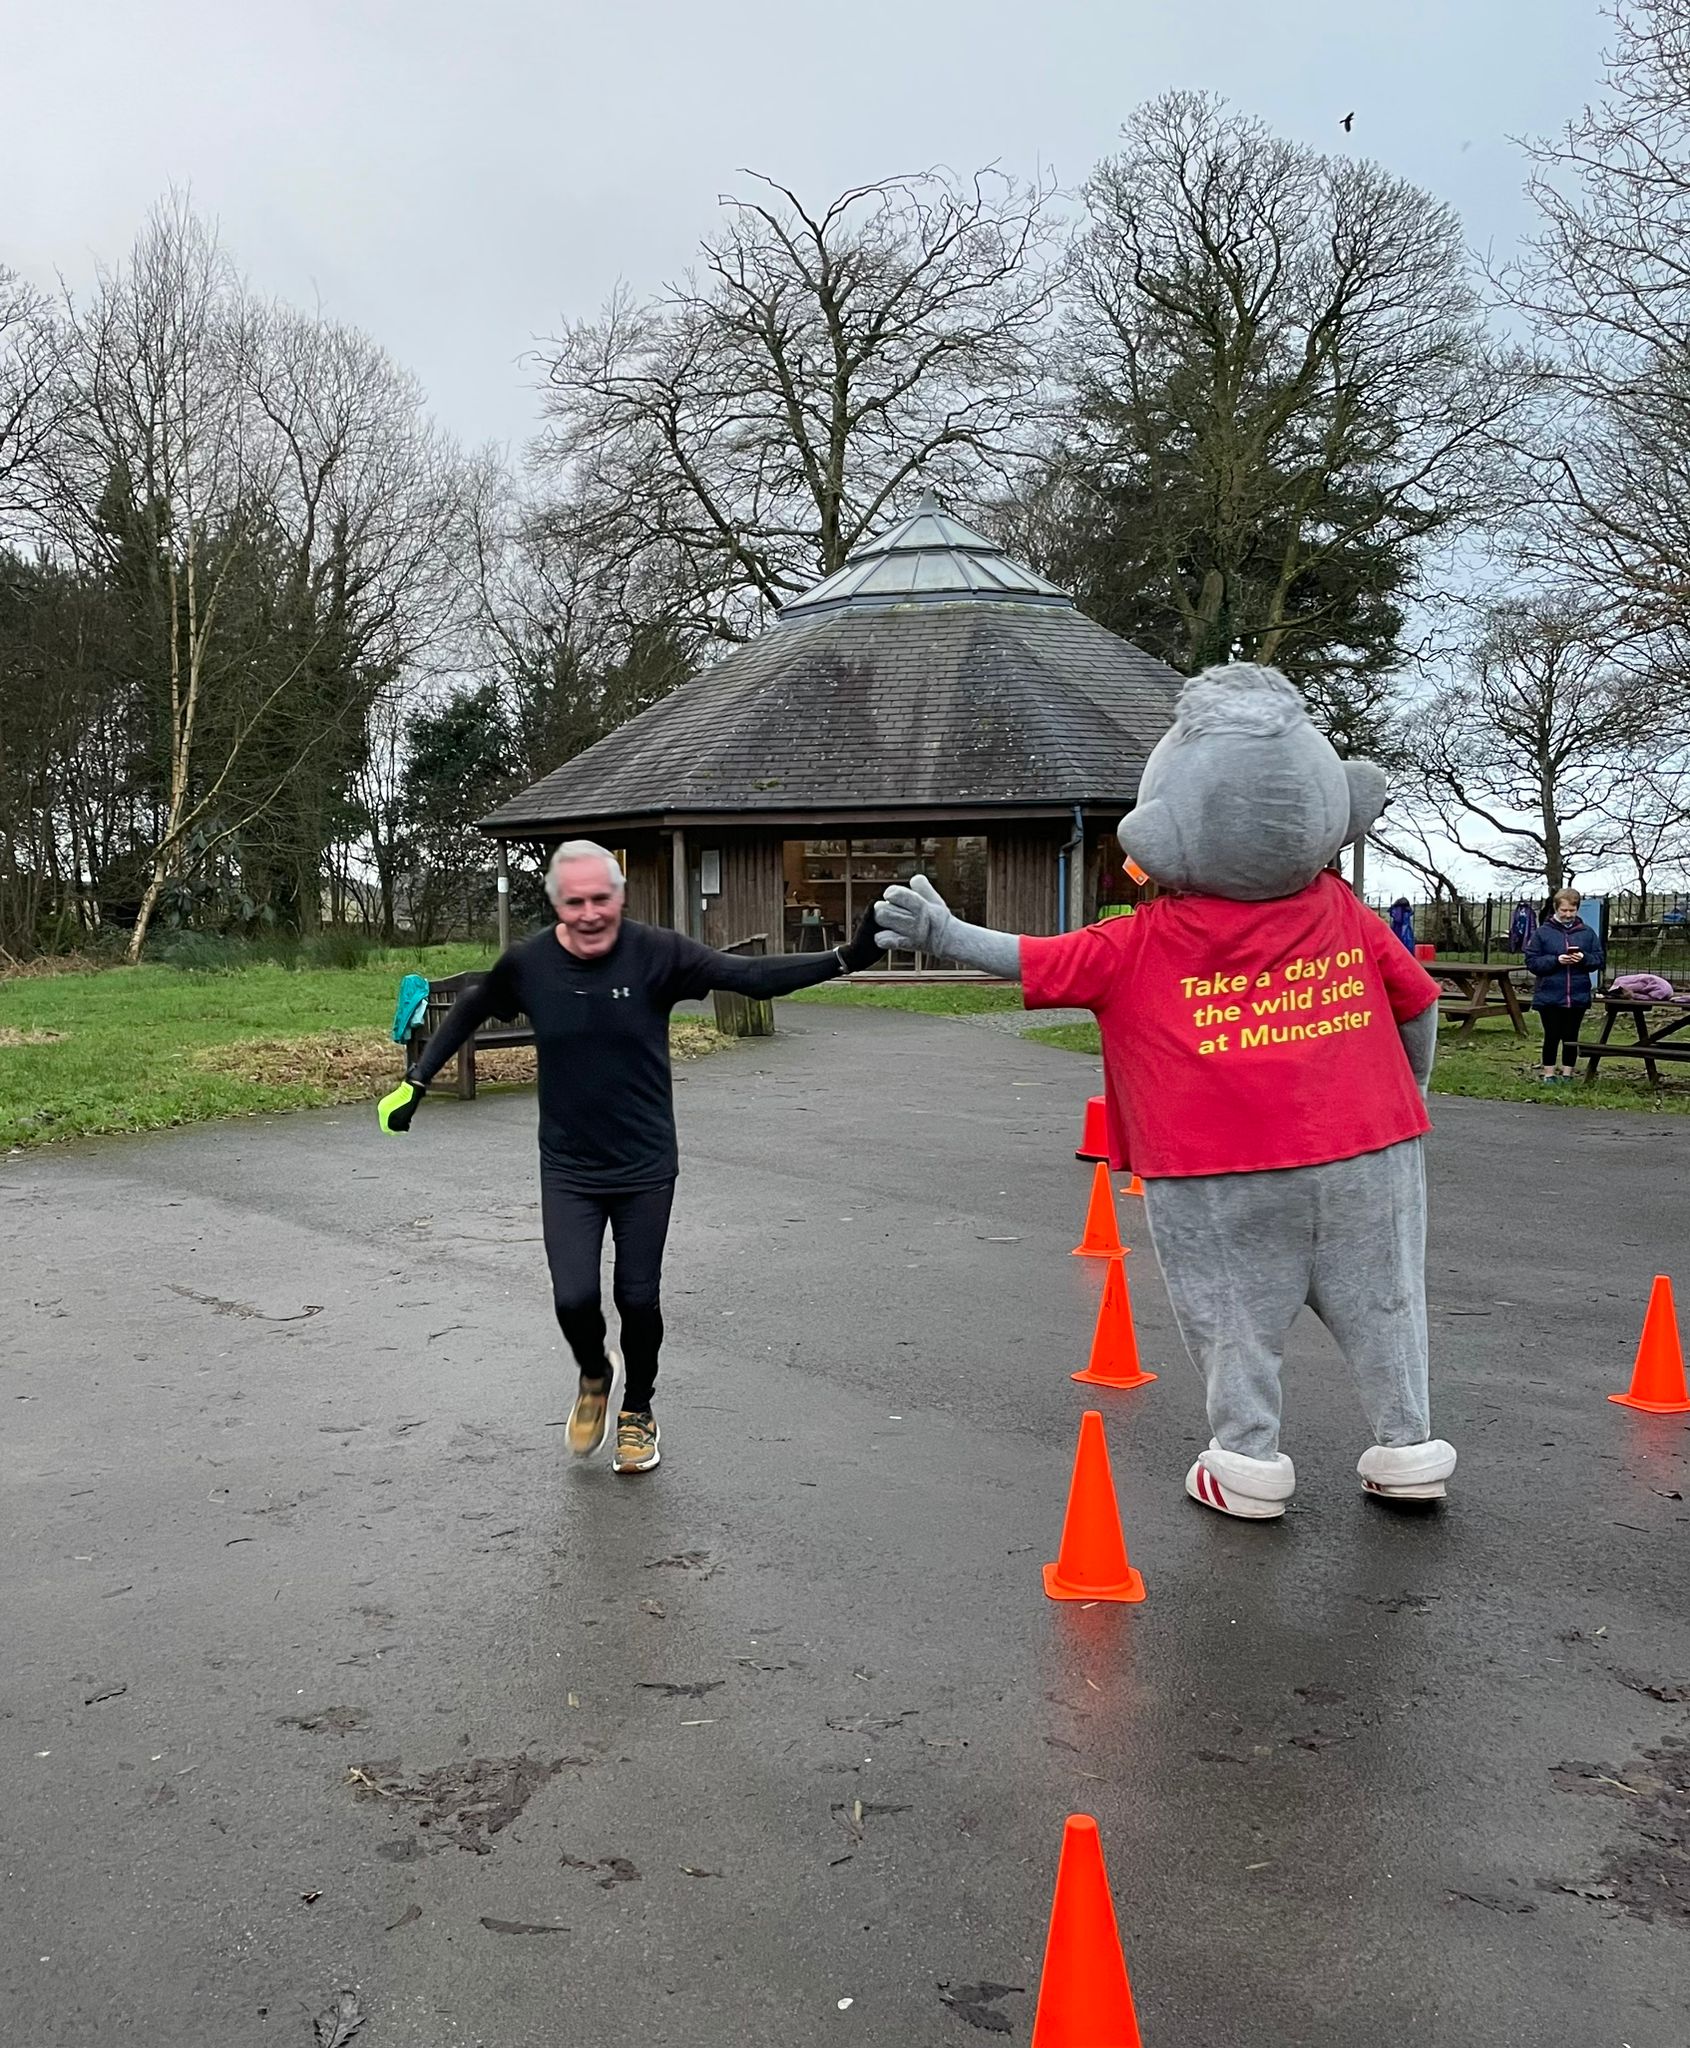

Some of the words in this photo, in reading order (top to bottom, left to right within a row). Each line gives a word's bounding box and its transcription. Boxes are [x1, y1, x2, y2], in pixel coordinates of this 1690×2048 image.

[1180, 971, 1248, 999] Take
[1255, 971, 1271, 988] a
[1284, 958, 1331, 982] day
[1335, 947, 1364, 968] on
[1192, 1004, 1242, 1028] the
[1251, 986, 1314, 1017] wild
[1321, 975, 1365, 1006] side
[1198, 1033, 1229, 1055] at
[1240, 1010, 1372, 1049] Muncaster
